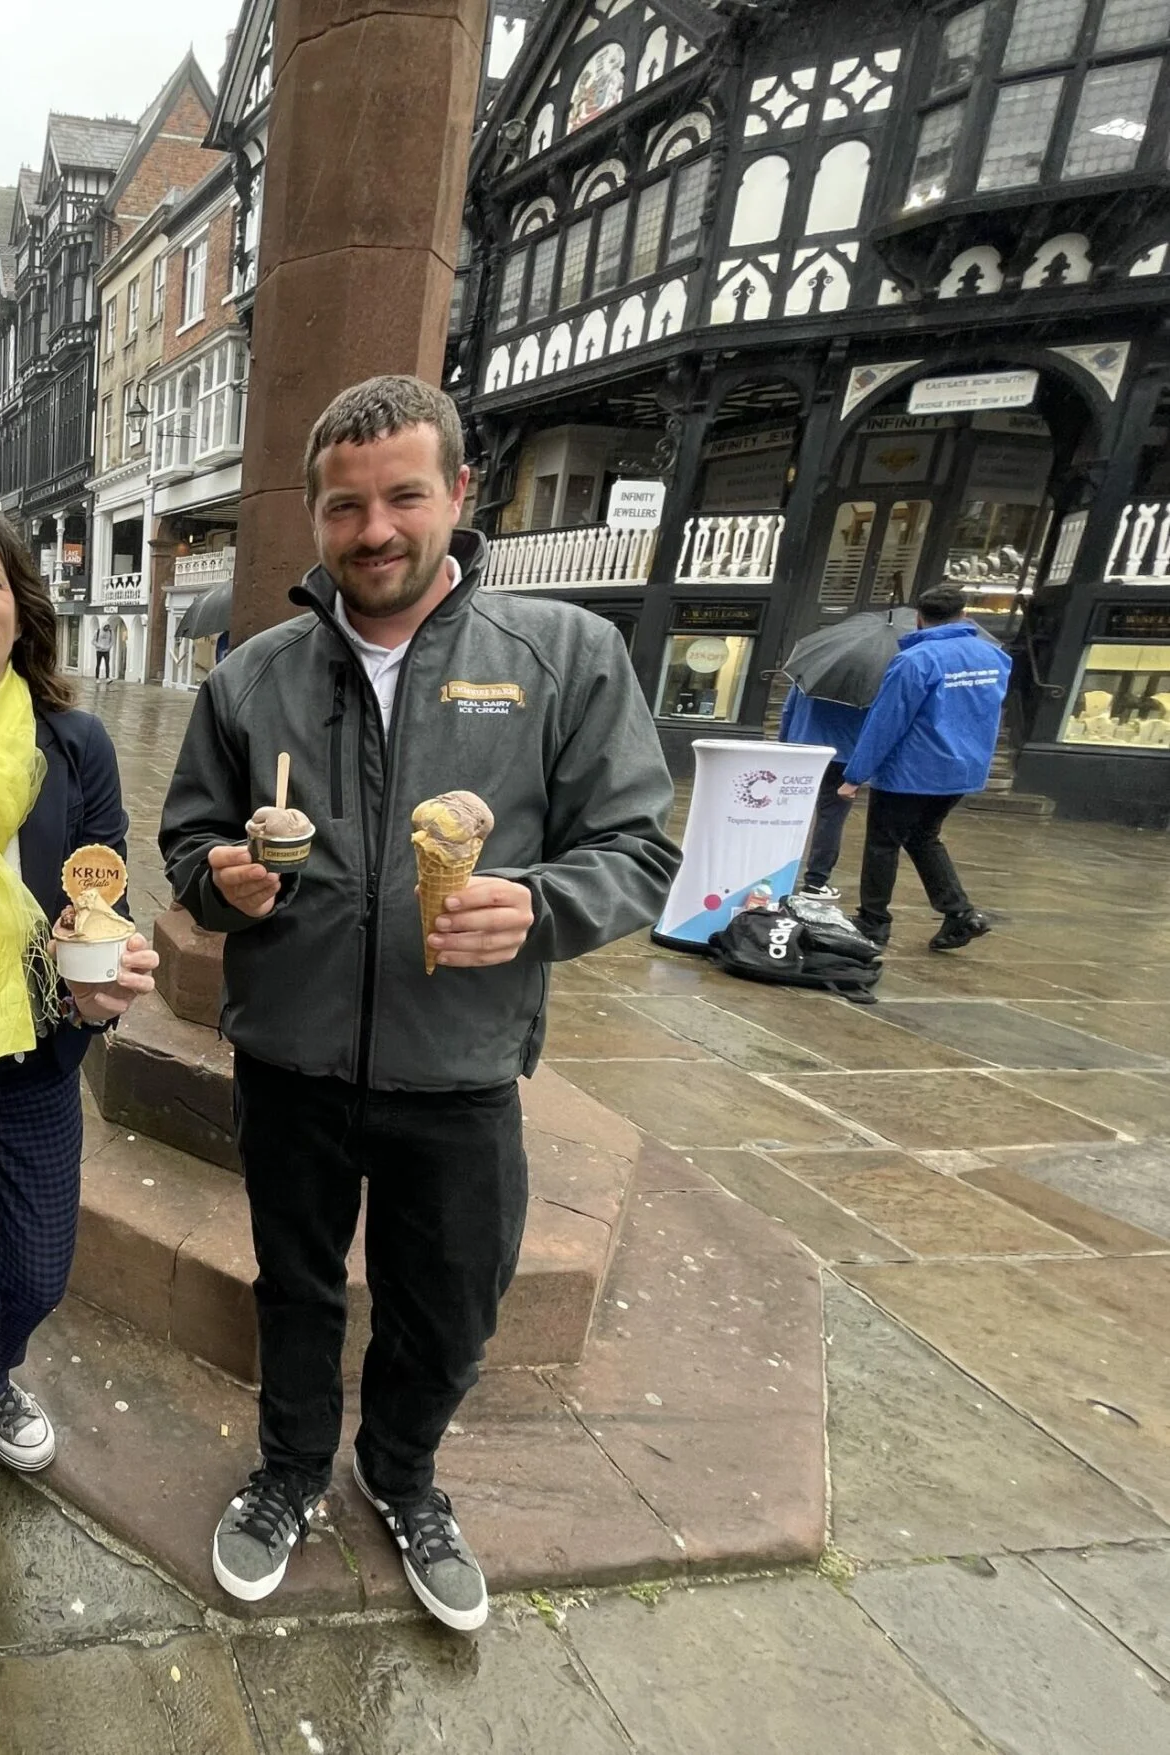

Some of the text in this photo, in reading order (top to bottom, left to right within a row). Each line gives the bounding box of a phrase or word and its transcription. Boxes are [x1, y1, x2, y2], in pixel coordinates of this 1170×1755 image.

[946, 398, 977, 408] STREET
[1002, 395, 1027, 403] EAST
[866, 414, 942, 430] INFINITY
[620, 492, 656, 502] INFINITY
[613, 507, 658, 518] JEWELLERS
[64, 555, 82, 563] LAND
[482, 700, 511, 708] DAIRY
[475, 707, 510, 715] CREAM
[782, 775, 814, 785] CANCER
[779, 786, 815, 796] RESEARCH
[72, 866, 120, 880] KRUM
